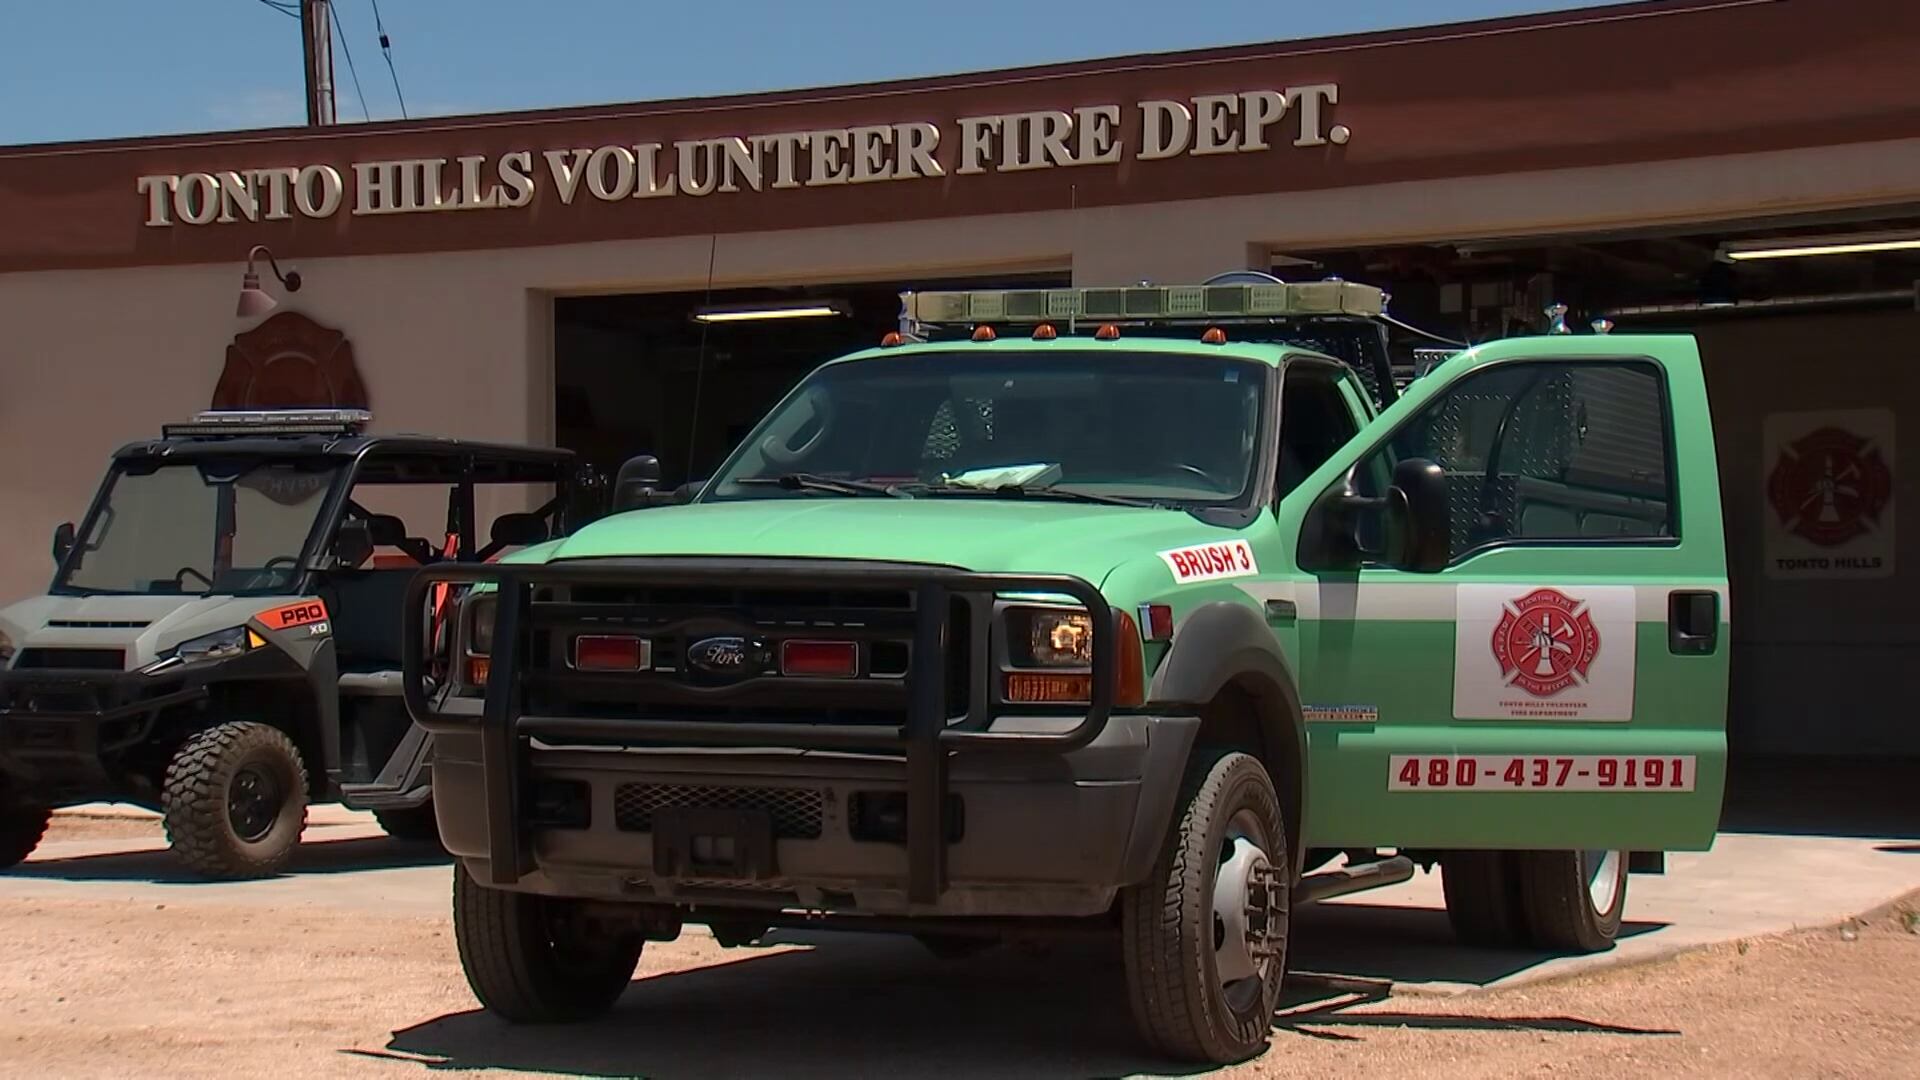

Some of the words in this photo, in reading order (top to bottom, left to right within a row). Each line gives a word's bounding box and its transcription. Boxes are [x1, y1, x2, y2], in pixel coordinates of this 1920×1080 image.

[138, 164, 343, 228] TONTO
[351, 151, 535, 216] HILLS
[543, 121, 946, 204] VOLUNTEER
[956, 103, 1123, 175] FIRE
[1136, 83, 1351, 161] DEPT.
[1170, 546, 1236, 578] BRUSH
[1236, 544, 1251, 570] 3
[1775, 558, 1830, 570] TONTO
[1834, 557, 1882, 569] HILLS
[280, 605, 323, 625] PRO
[1399, 758, 1683, 787] 480-437-9191
